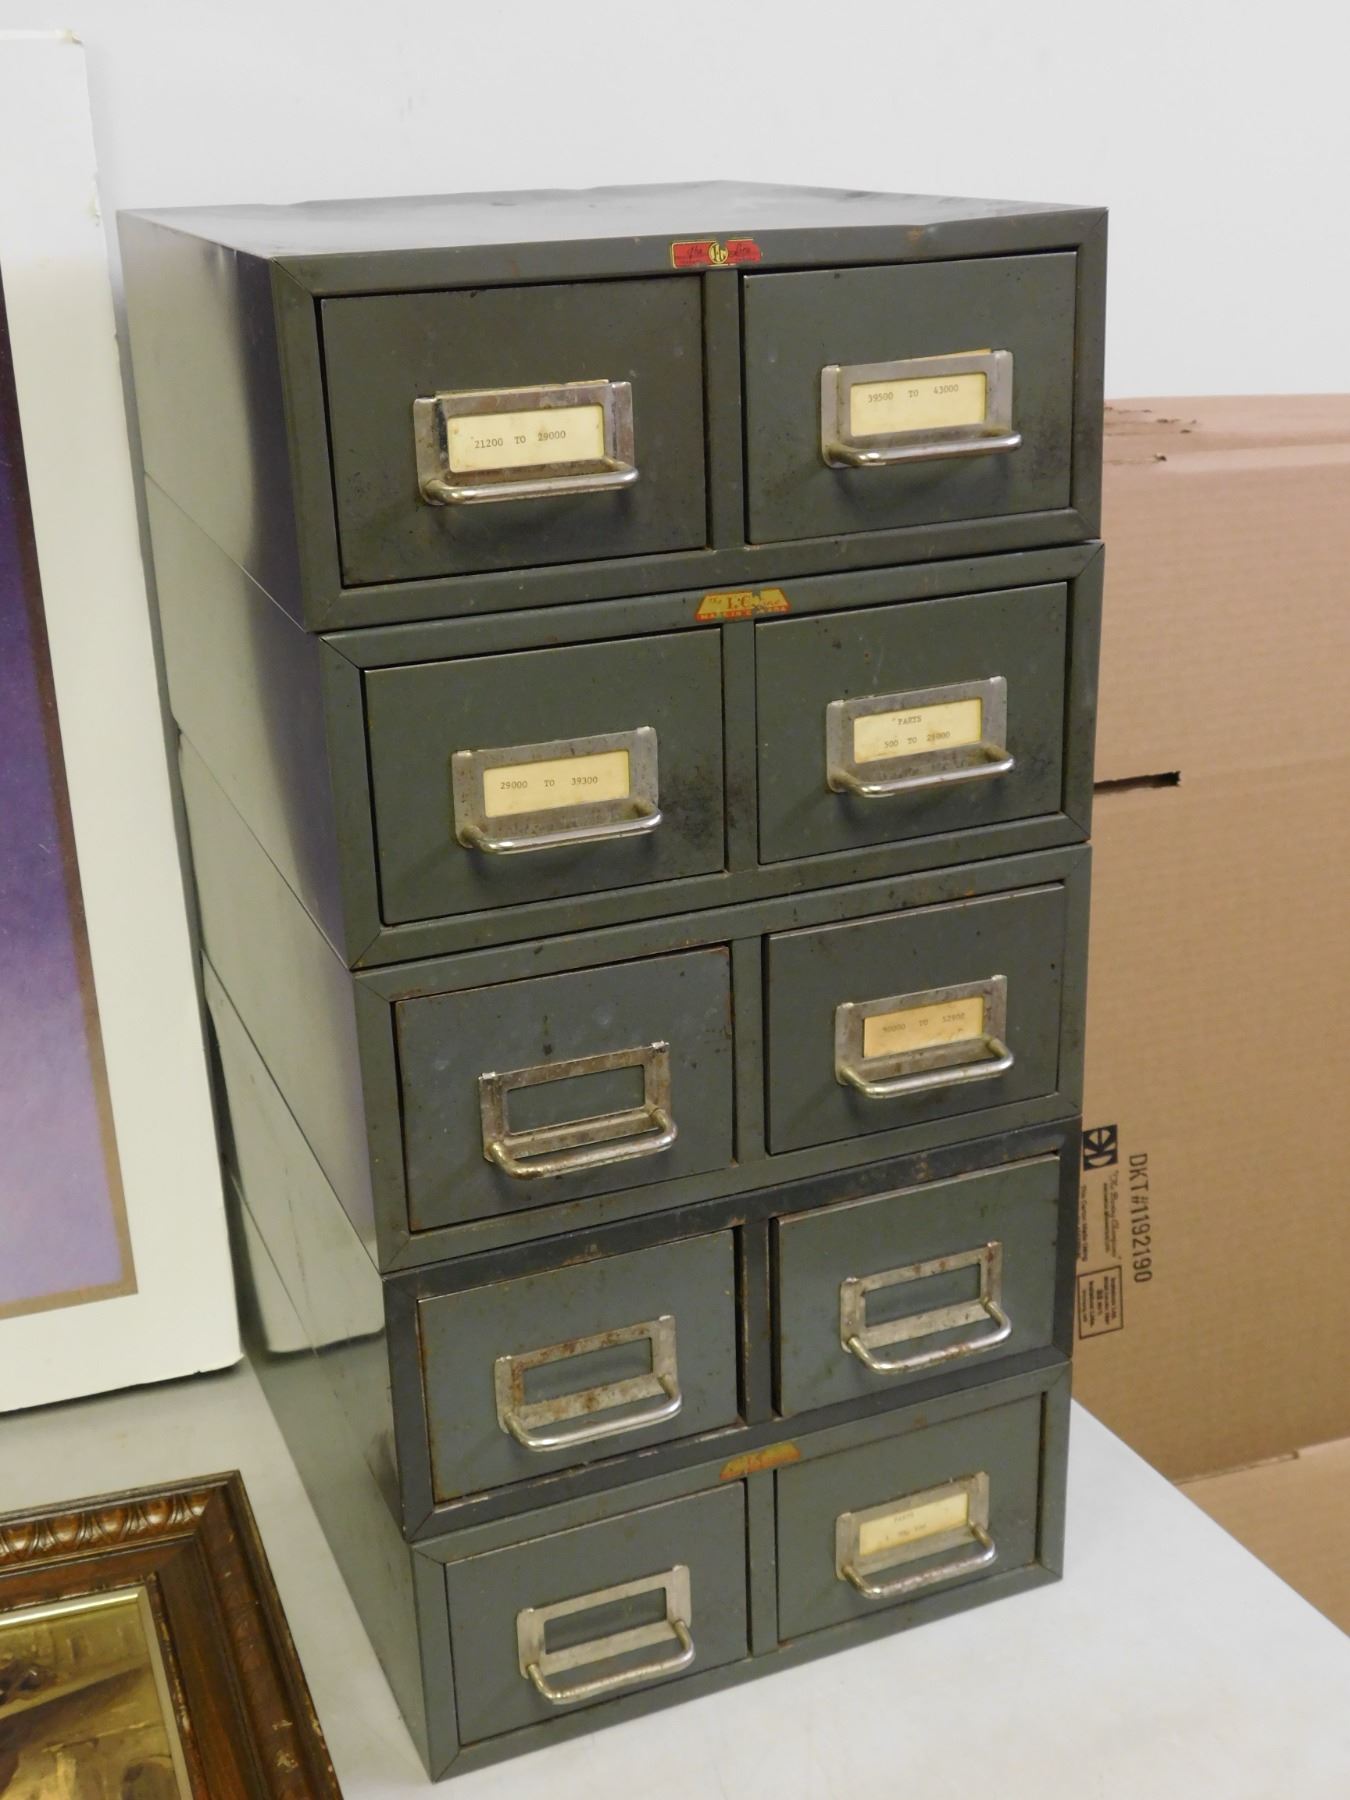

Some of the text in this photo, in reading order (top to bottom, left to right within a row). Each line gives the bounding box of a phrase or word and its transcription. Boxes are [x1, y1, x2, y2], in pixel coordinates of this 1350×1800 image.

[908, 389, 919, 399] TO
[474, 438, 504, 449] 21200
[514, 435, 526, 445] TO
[907, 736, 918, 745] TO
[544, 779, 555, 788] TO
